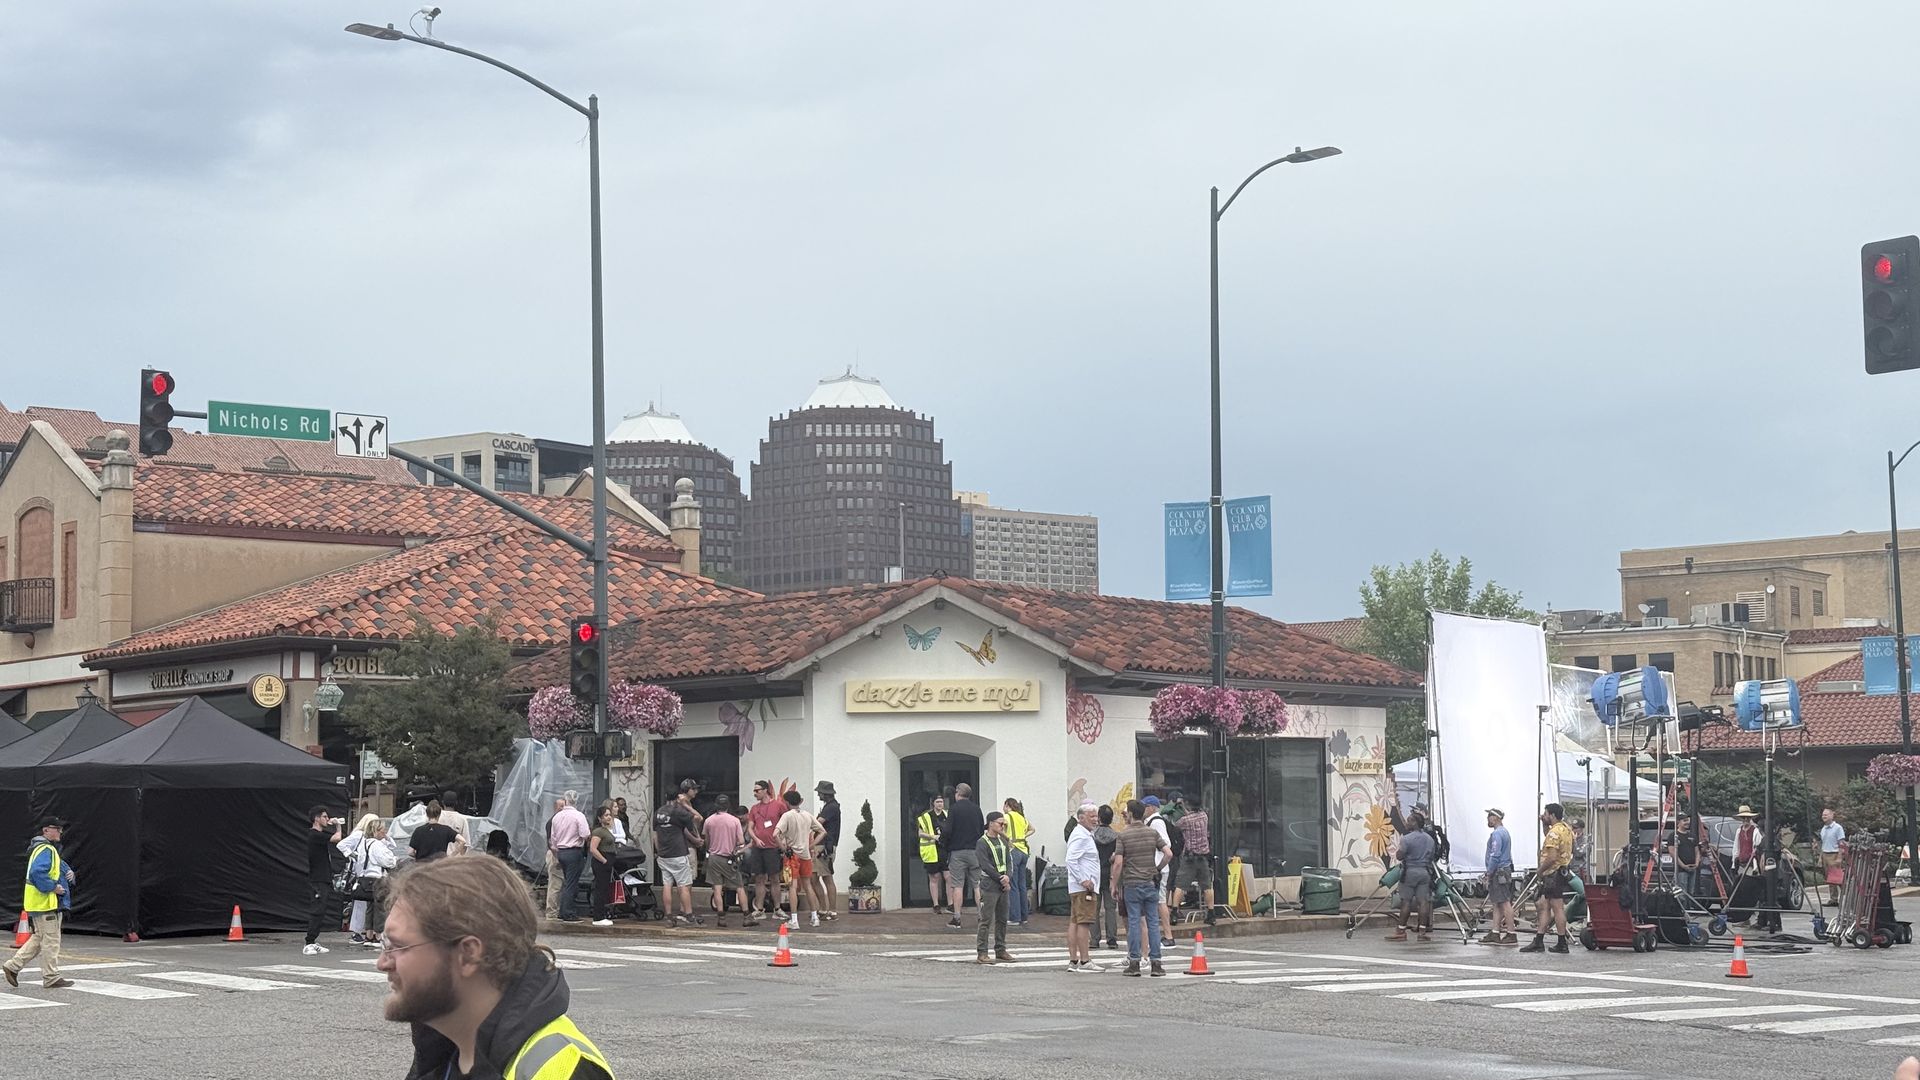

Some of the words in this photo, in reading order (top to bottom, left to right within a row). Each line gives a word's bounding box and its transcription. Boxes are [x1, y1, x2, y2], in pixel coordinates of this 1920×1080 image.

[219, 409, 288, 431] Nichols
[300, 416, 320, 434] Rd
[492, 438, 535, 453] CASCADE
[366, 450, 385, 458] ONLY
[1169, 510, 1205, 519] COUNTRY
[1230, 504, 1266, 515] COUNTRY
[1169, 519, 1190, 528] CLUB
[1231, 514, 1251, 524] CLUB
[1169, 528, 1194, 536] PLAZA
[1232, 523, 1255, 532] PLAZA
[333, 656, 386, 674] POTBE
[184, 672, 213, 685] SANDWICH
[214, 669, 231, 682] SHOP
[853, 681, 933, 708] dazzle
[938, 686, 977, 702] me
[982, 680, 1032, 711] moi
[1345, 760, 1362, 772] dazzle
